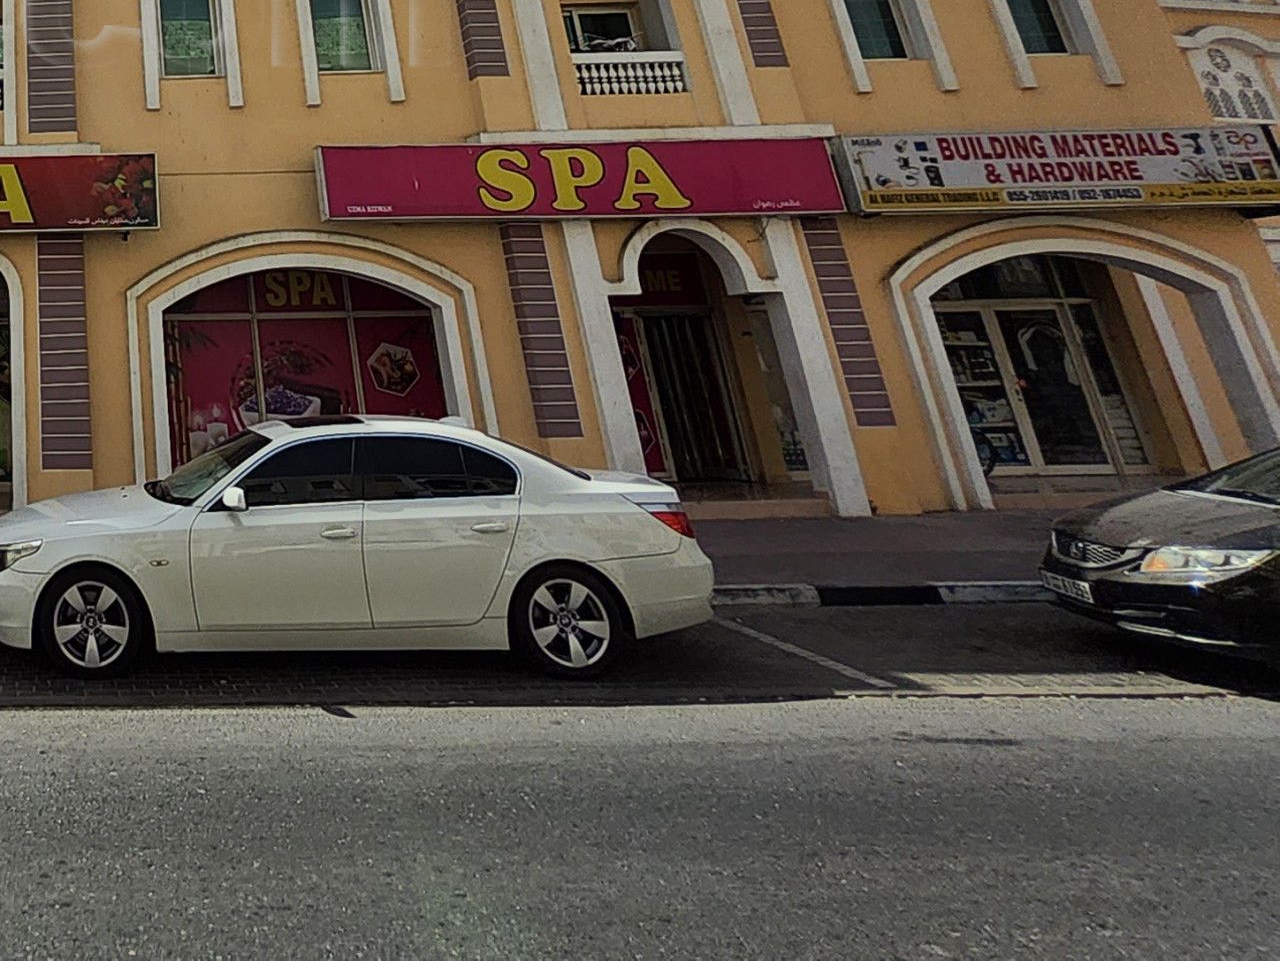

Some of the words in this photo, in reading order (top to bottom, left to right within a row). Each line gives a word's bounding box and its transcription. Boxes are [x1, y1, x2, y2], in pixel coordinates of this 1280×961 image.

[936, 135, 1048, 162] BUILDING
[1049, 132, 1180, 158] MATERIALS
[475, 145, 693, 212] SPA
[984, 163, 1005, 184] &
[1006, 160, 1144, 184] HARDWARE
[264, 270, 337, 307] SPA
